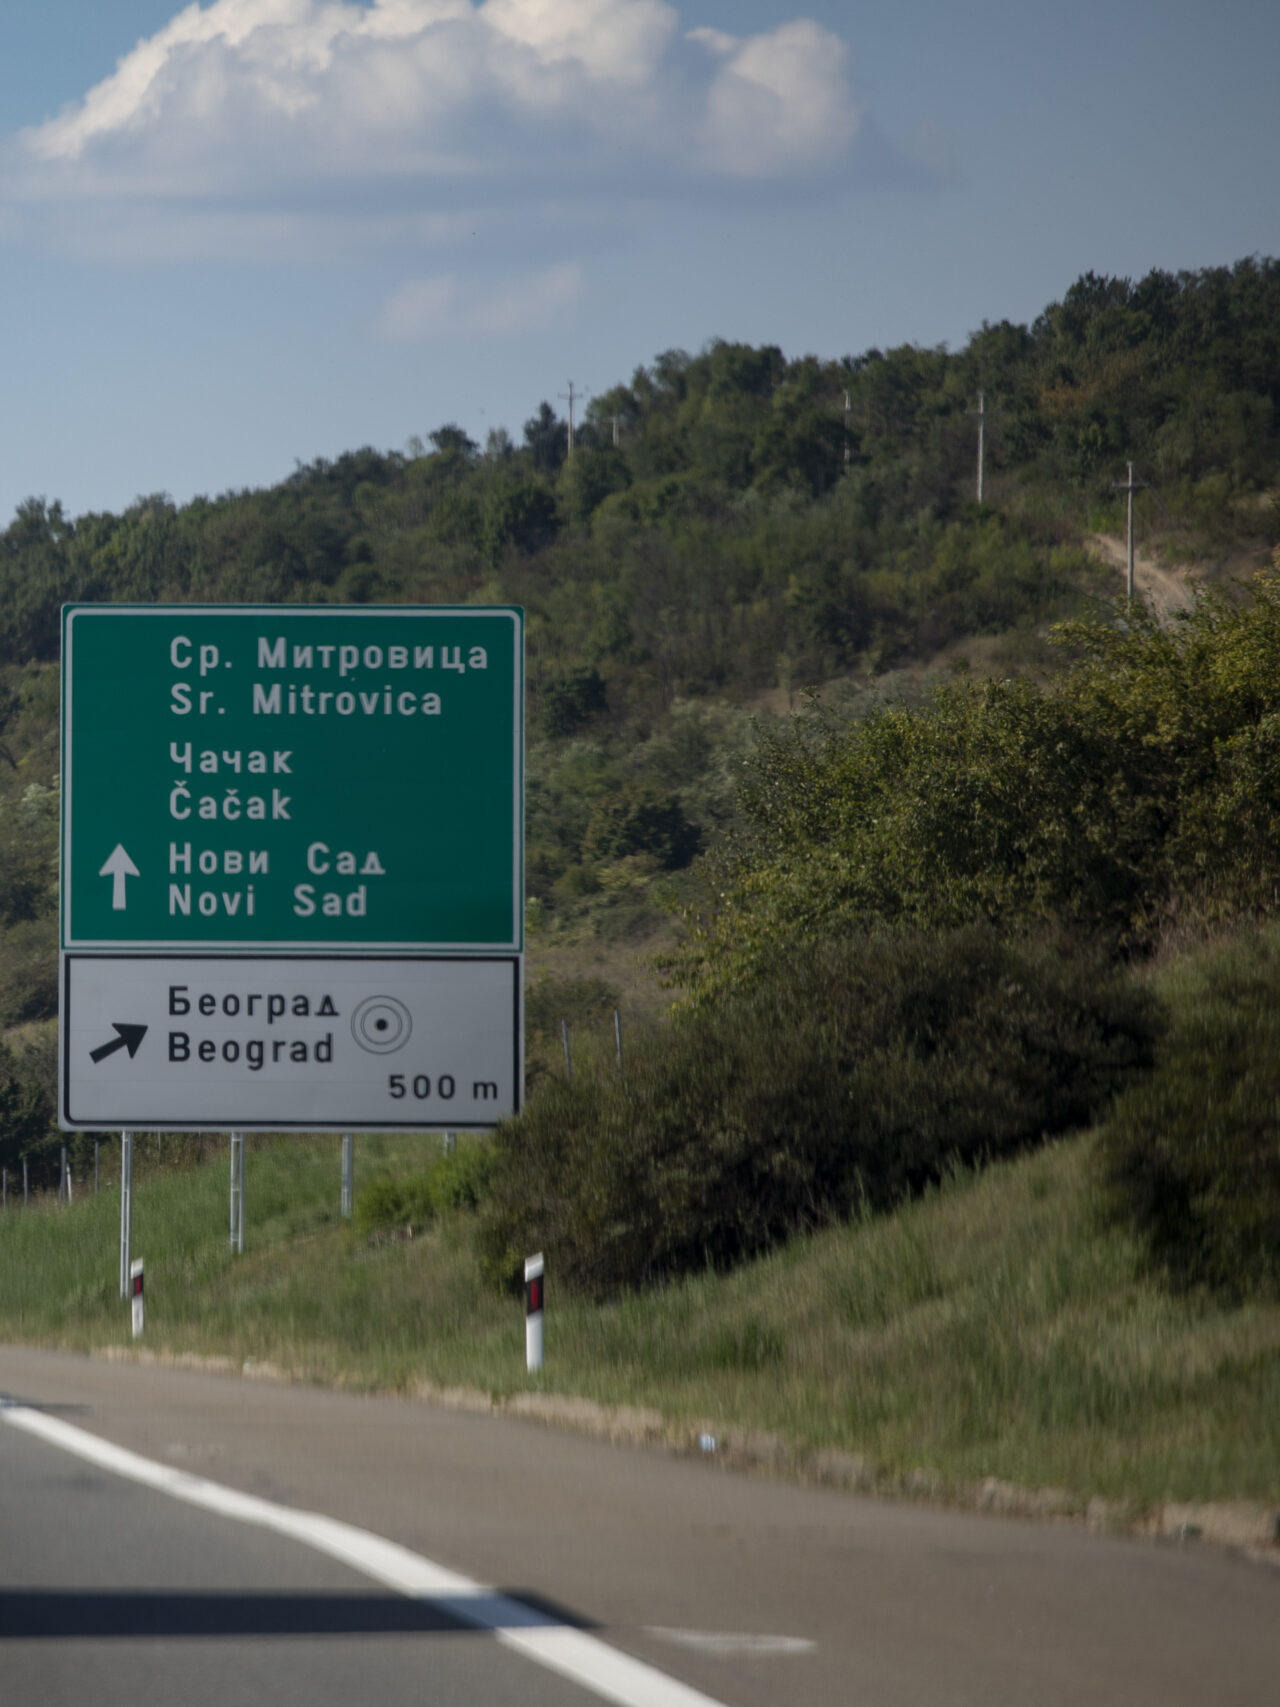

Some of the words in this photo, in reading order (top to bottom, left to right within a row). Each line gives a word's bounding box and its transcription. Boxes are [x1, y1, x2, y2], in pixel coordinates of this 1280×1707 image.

[170, 635, 232, 677] Ср.
[257, 636, 488, 677] Митровица
[170, 682, 226, 715] Sr.
[252, 683, 442, 716] Mitrovica
[169, 741, 293, 774] Чачак
[169, 780, 292, 821] Čačak
[169, 841, 269, 875] Нови
[306, 841, 386, 875] Сад
[168, 883, 255, 917] Novi
[293, 883, 367, 917] Sad
[168, 985, 340, 1025] Београд
[168, 1031, 334, 1072] Beograd
[388, 1074, 456, 1101] 500
[472, 1081, 498, 1101] m
